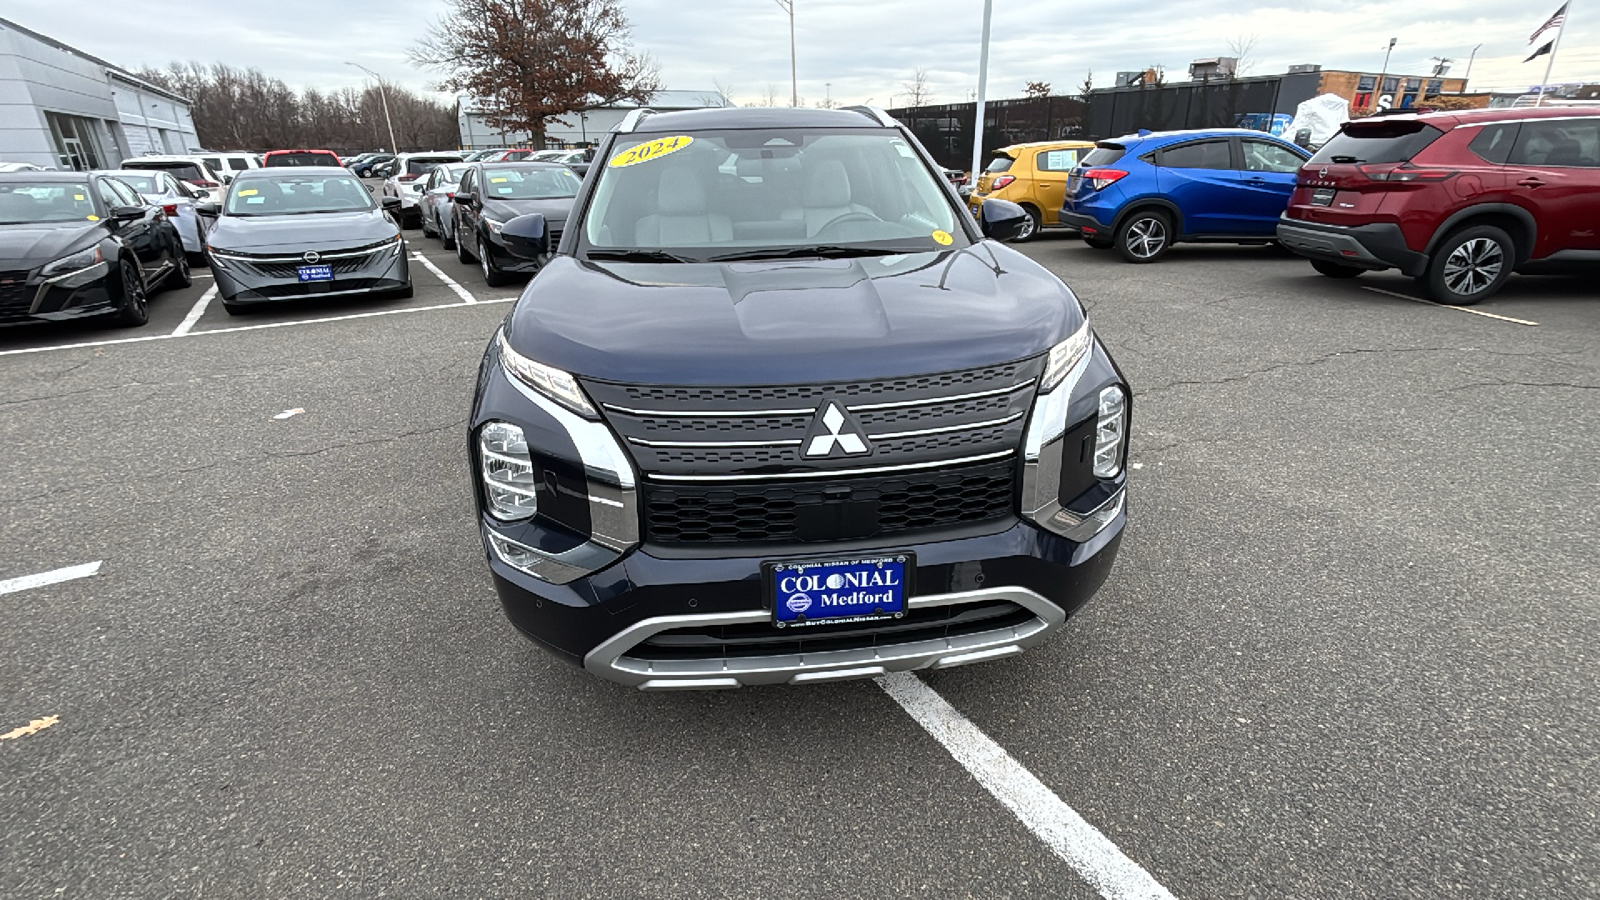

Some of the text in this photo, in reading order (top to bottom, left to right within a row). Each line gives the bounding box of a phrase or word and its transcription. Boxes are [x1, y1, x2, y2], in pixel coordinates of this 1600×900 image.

[625, 137, 680, 163] 2024
[788, 562, 822, 570] COLONIAL
[861, 557, 893, 565] MEDFORD
[780, 569, 899, 594] COLONIAL
[820, 590, 893, 607] Medford
